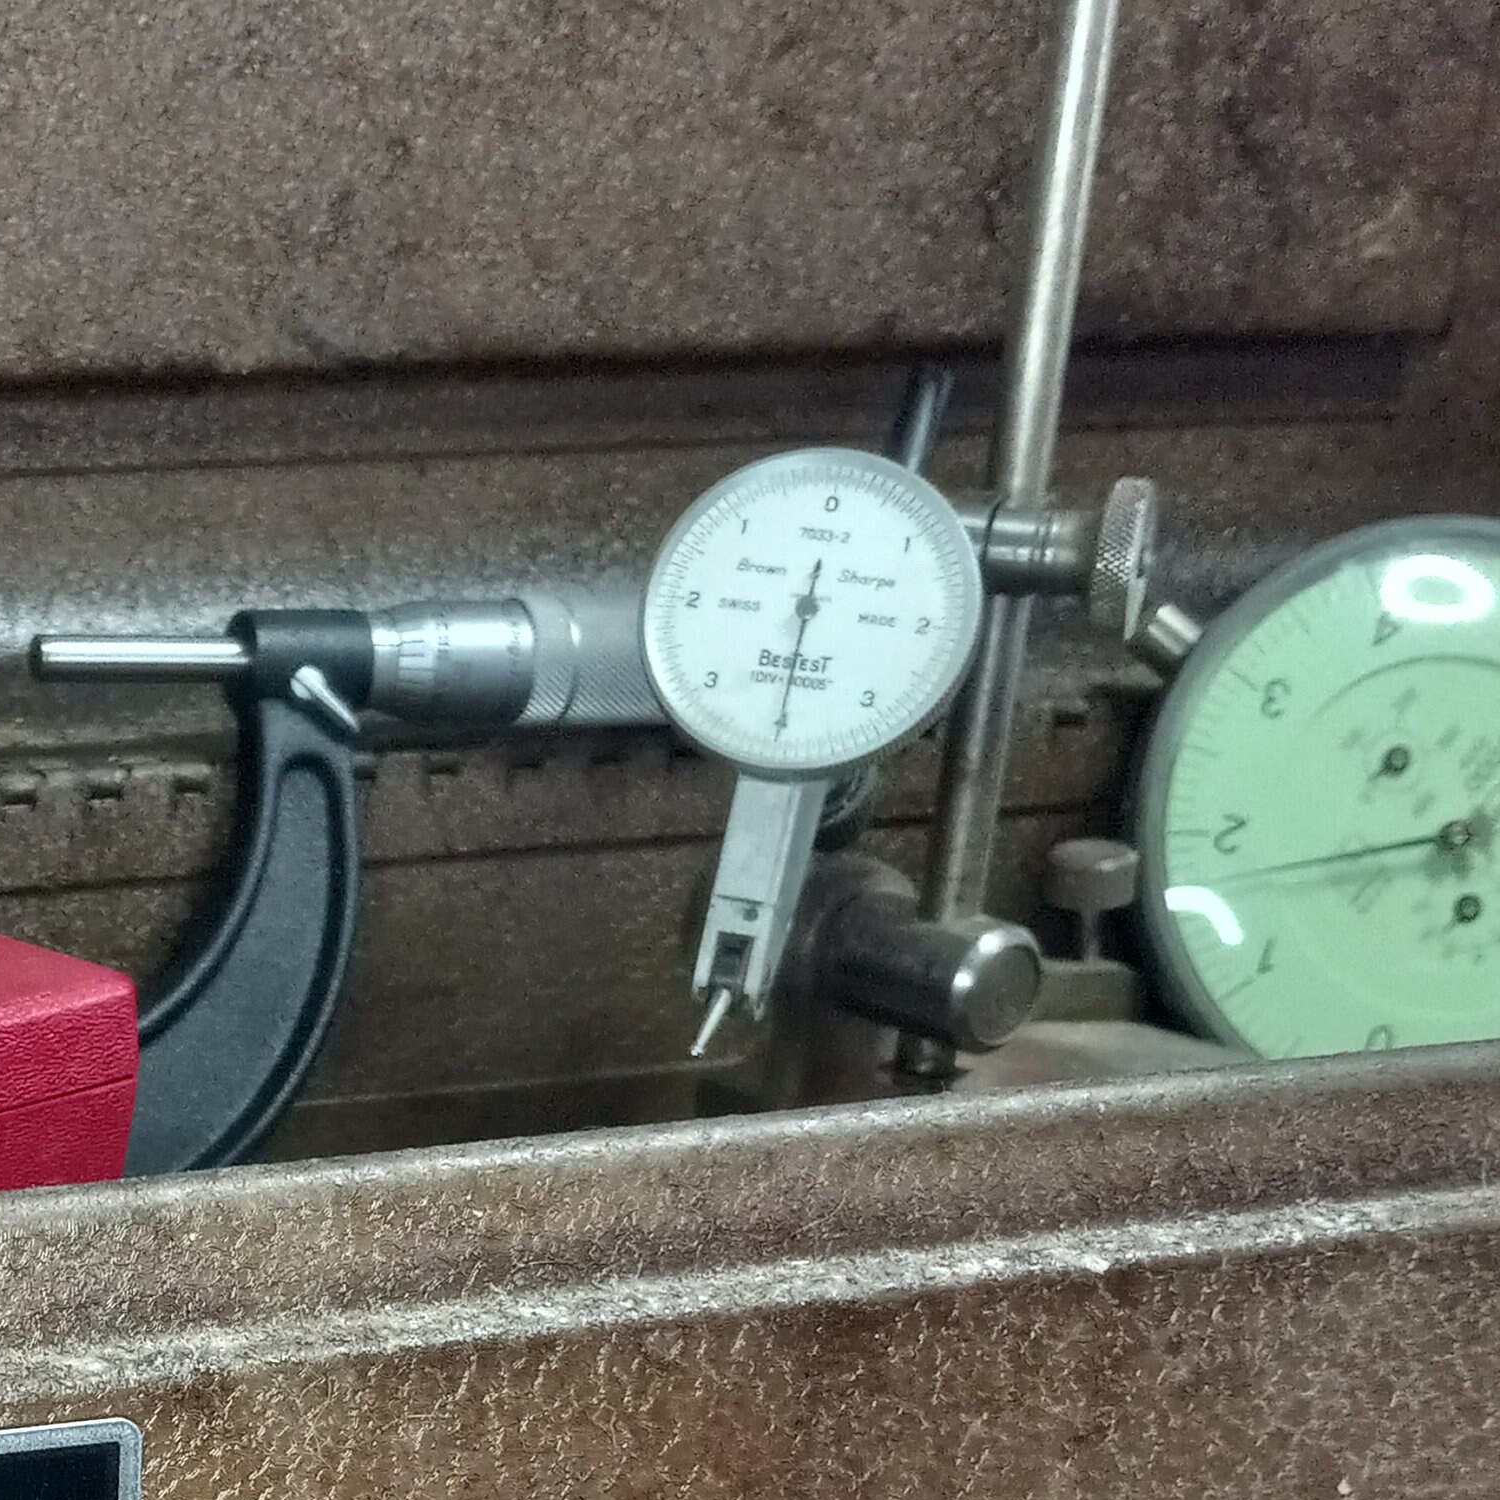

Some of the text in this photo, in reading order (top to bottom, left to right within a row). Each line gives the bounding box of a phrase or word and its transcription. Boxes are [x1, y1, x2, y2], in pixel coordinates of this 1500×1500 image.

[736, 557, 788, 577] Brown
[837, 568, 896, 591] Sharpe
[685, 591, 701, 609] 2
[858, 612, 897, 628] MADE
[914, 617, 931, 636] 2
[704, 671, 718, 688] 3
[860, 690, 876, 708] 3
